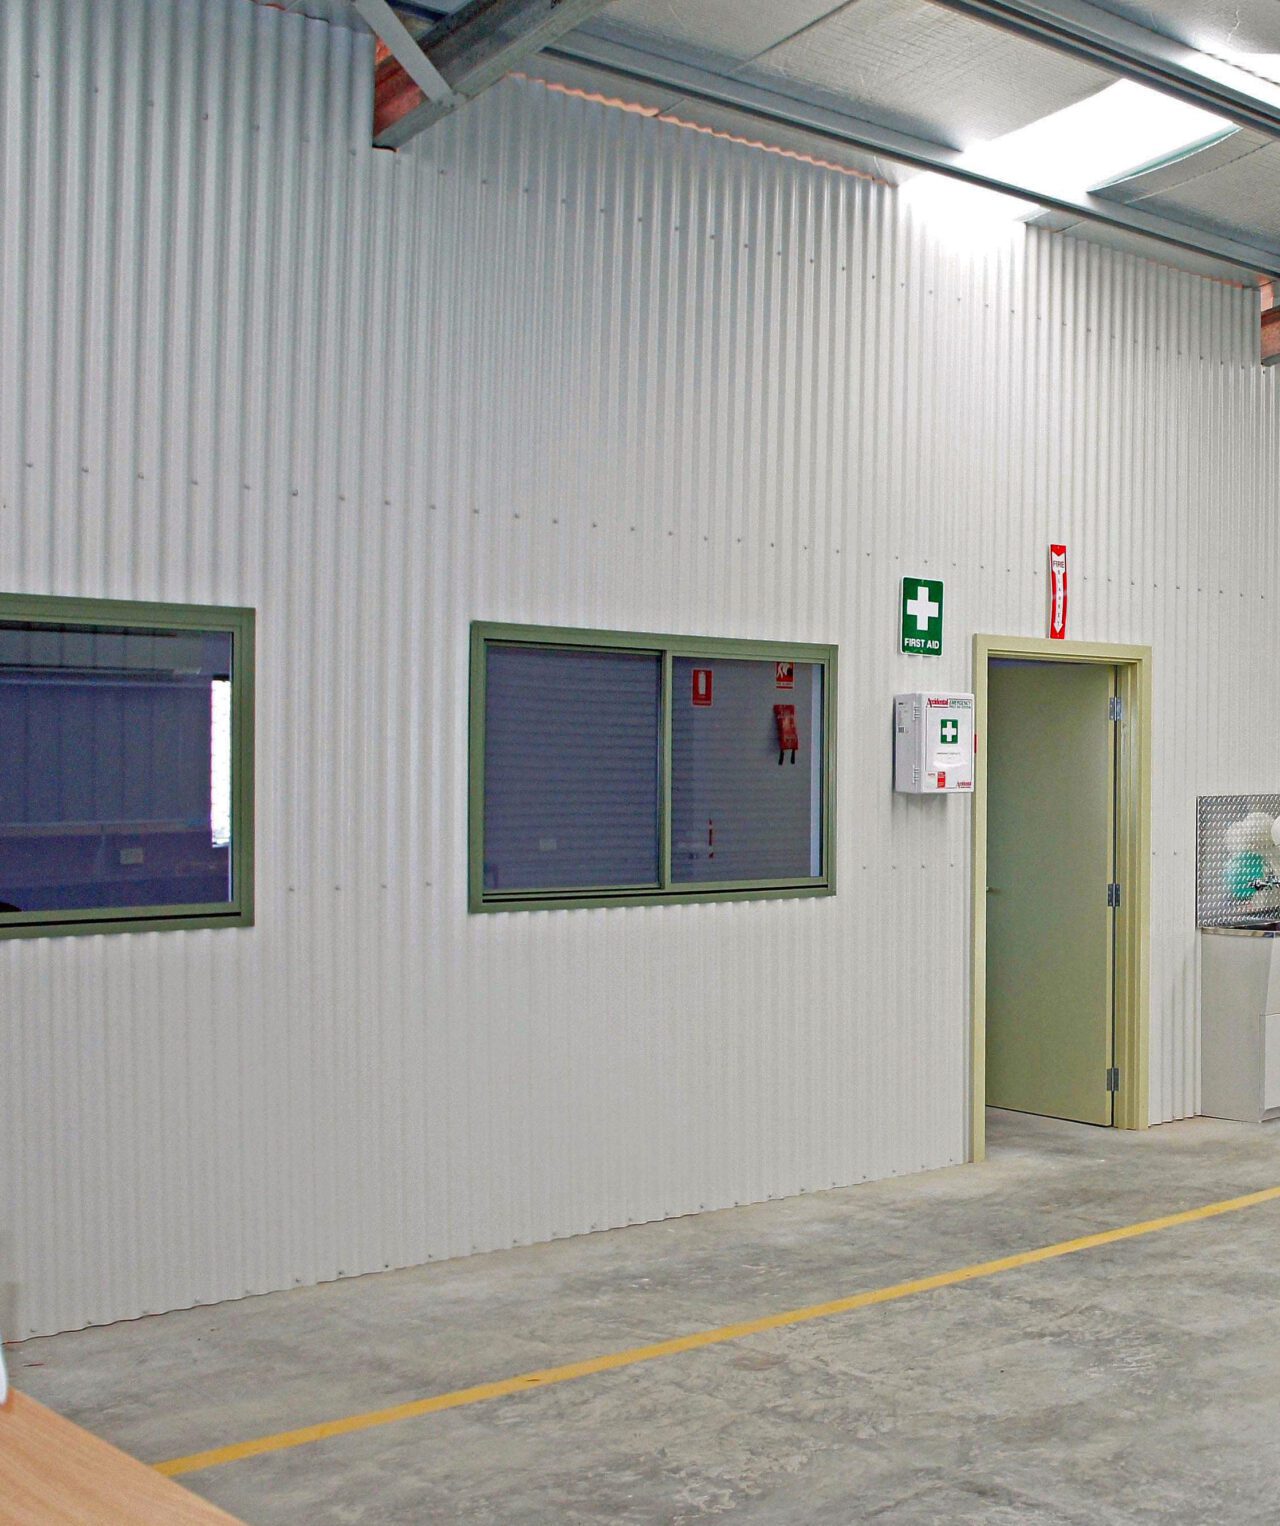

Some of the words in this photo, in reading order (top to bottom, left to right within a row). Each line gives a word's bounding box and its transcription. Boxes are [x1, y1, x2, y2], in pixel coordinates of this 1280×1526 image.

[1053, 560, 1065, 569] FIRE
[904, 637, 925, 648] FIRST
[926, 640, 940, 649] AID
